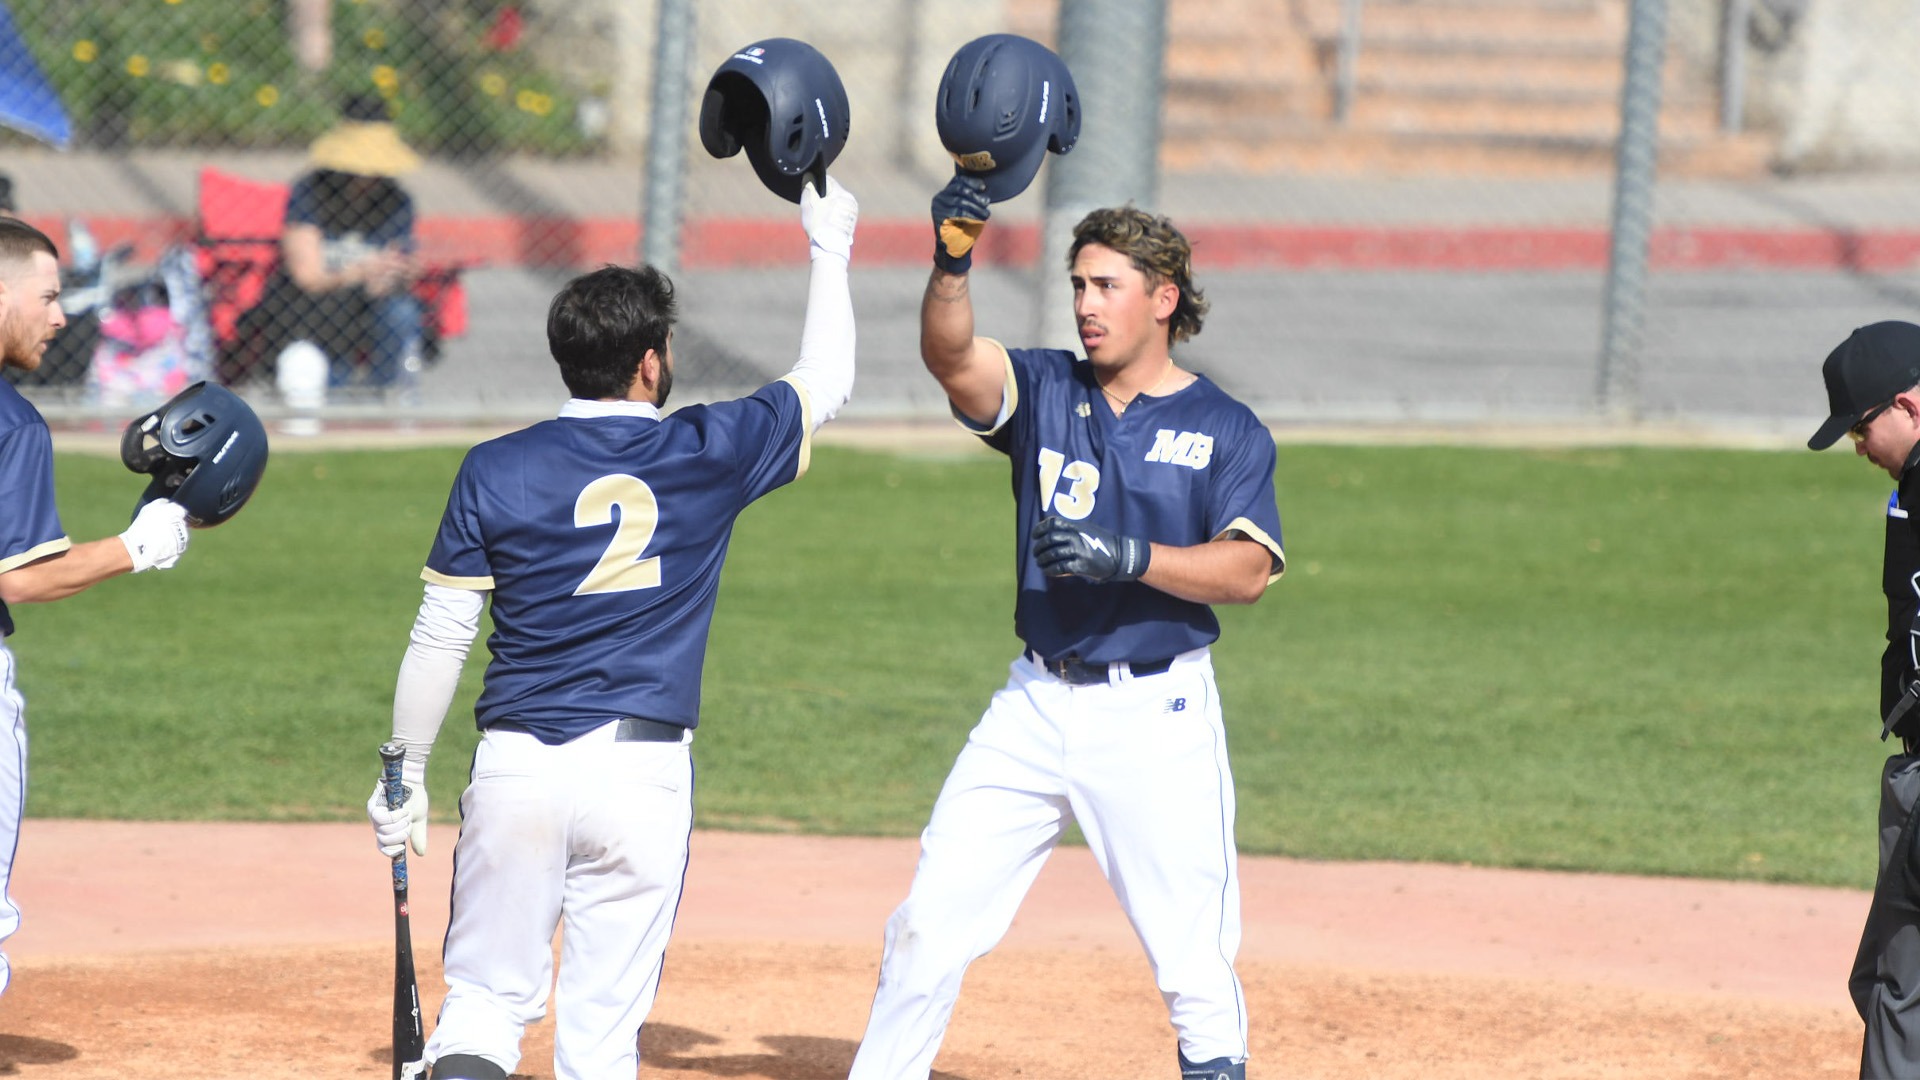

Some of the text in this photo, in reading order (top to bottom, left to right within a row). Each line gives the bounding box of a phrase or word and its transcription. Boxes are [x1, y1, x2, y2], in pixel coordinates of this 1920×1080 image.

[1038, 447, 1100, 520] 13
[1144, 428, 1214, 470] MB
[572, 473, 662, 597] 2
